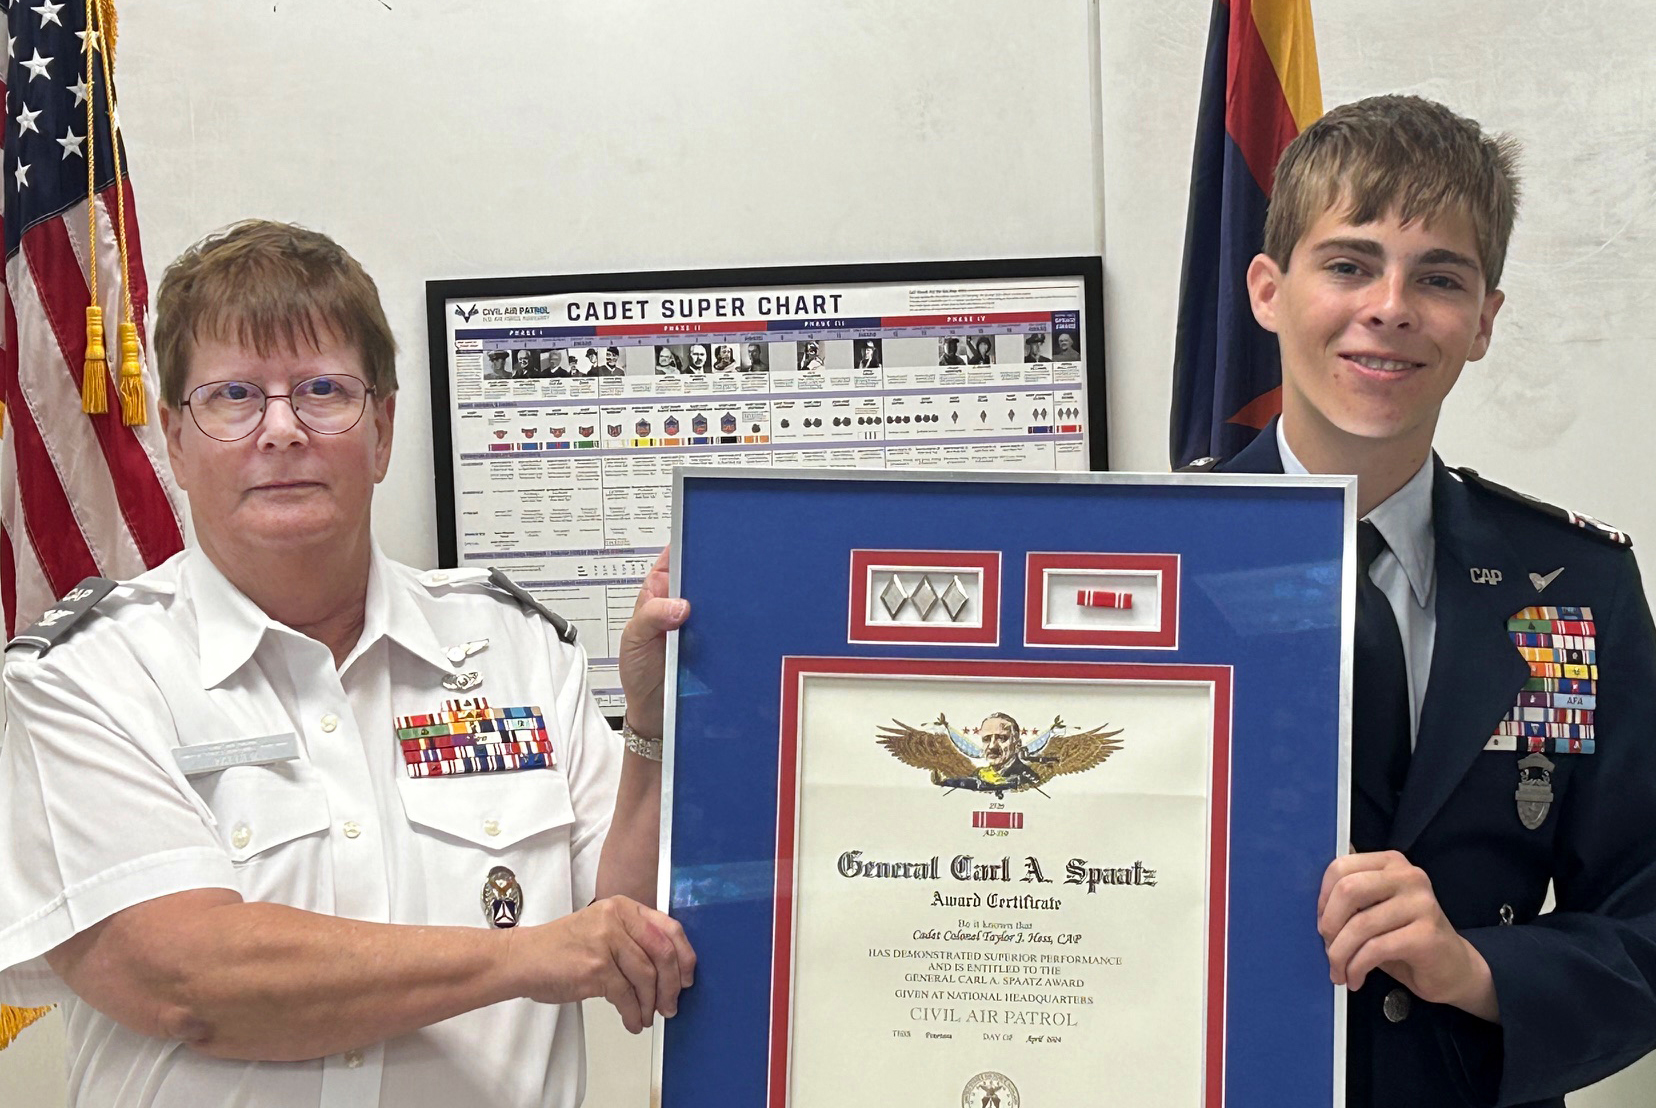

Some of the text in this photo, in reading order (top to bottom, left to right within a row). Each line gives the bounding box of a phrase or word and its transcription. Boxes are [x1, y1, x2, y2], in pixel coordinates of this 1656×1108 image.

[482, 306, 550, 316] CIVIL AIR PATROL
[567, 294, 843, 322] CADET SUPER CHART
[1470, 567, 1503, 585] CAP
[1567, 696, 1583, 705] AFA
[837, 849, 1158, 894] General Carl A. Spaatz
[930, 890, 1062, 911] Award Certificate
[982, 920, 1013, 930] known
[1016, 921, 1033, 930] that
[912, 929, 941, 940] Cadet
[944, 929, 982, 941] Colonel
[982, 931, 1015, 945] Taylor
[1015, 932, 1025, 944] J.
[1057, 933, 1082, 945] CAP
[868, 949, 1123, 966] HAS DEMONSTRATED SUPERIOR PERFORMANCE
[928, 963, 1061, 975] AND IS ENTITLED TO THE
[904, 973, 1085, 988] GENERAL CARL A. SPAATZ AWARD
[895, 989, 1094, 1005] GIVEN AT NATIONAL HEADQUARTERS
[909, 1006, 1079, 1027] CIVIL AIR PATROL
[983, 1033, 1001, 1041] DAY
[1002, 1033, 1013, 1041] OF
[1025, 1034, 1045, 1045] April
